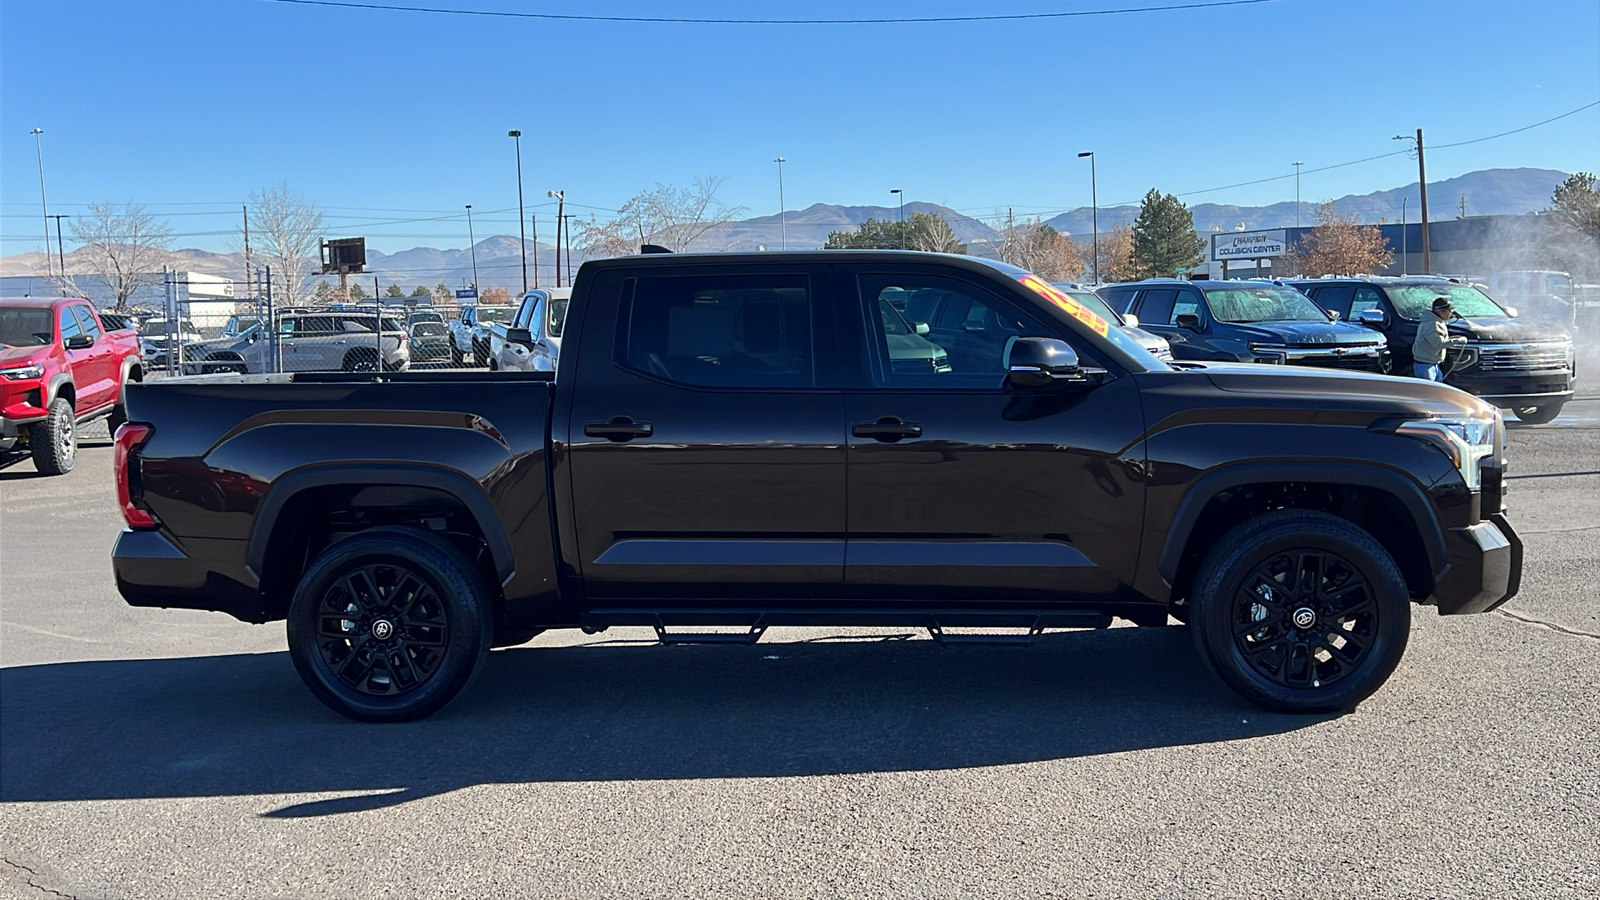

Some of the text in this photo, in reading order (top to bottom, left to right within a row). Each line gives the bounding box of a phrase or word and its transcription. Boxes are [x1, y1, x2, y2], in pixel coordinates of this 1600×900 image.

[1233, 235, 1266, 247] CHAMPION
[1220, 245, 1280, 255] COLLISION CENTER
